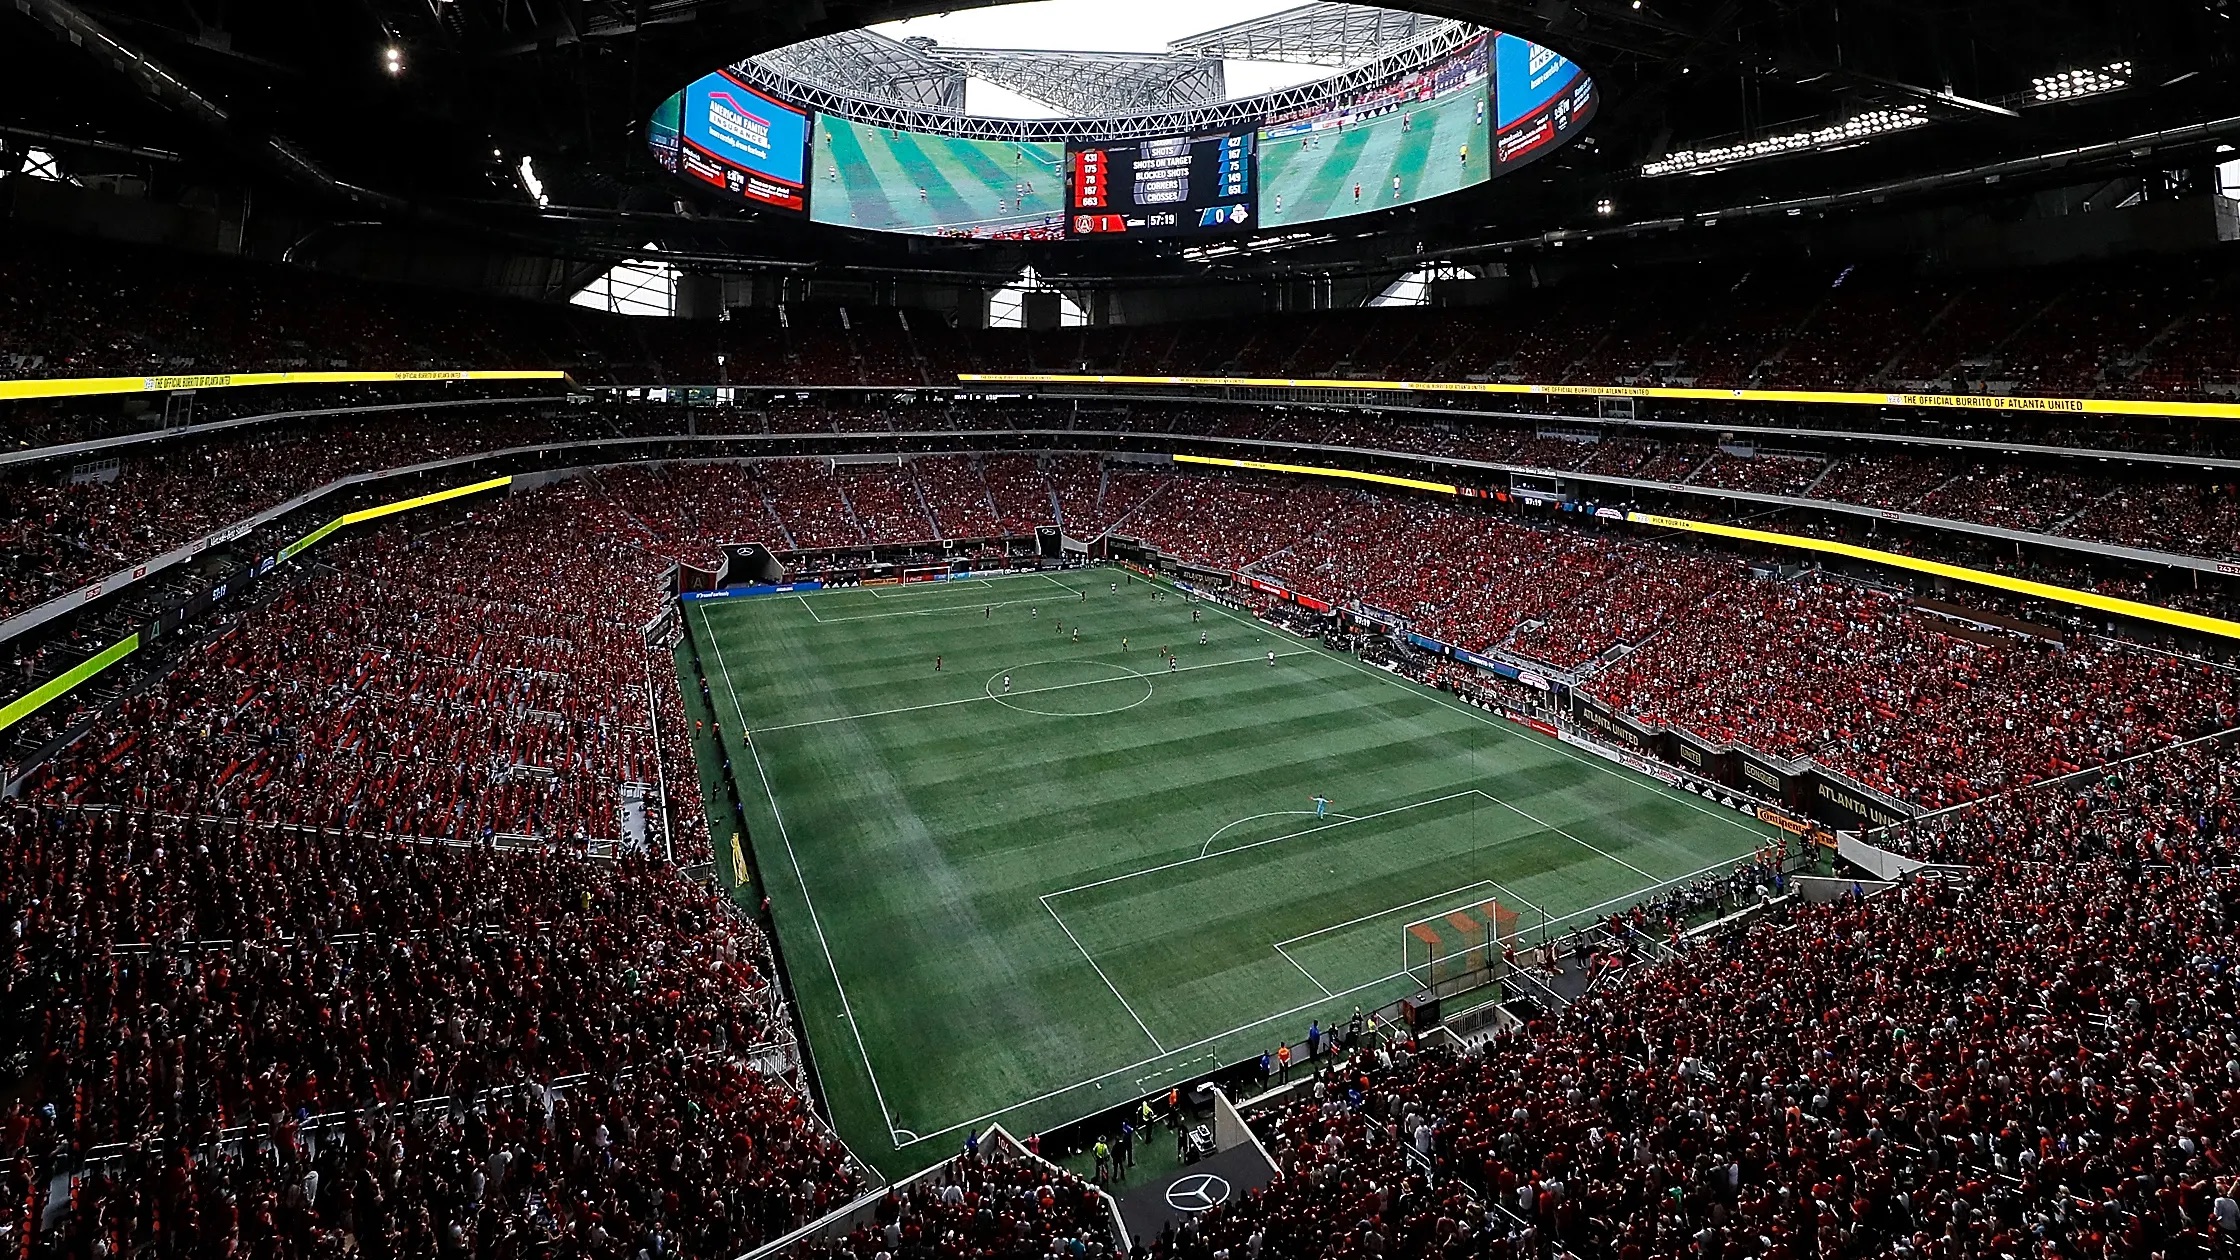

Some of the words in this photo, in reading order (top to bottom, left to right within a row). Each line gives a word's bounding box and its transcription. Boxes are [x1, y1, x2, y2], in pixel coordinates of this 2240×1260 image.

[710, 100, 742, 127] AMERICAN
[743, 118, 769, 137] FAMILY
[713, 115, 763, 144] INSURANCE
[1227, 138, 1242, 148] 427
[1152, 146, 1174, 156] SHOTS
[1228, 150, 1241, 158] 167
[1133, 160, 1155, 170] SHOTS
[1156, 159, 1166, 168] ON
[1166, 156, 1192, 166] TARGET
[1230, 162, 1240, 170] 75
[1084, 165, 1098, 174] 175
[1136, 170, 1166, 180] BLOCKED
[1167, 168, 1190, 178] SHOTS
[1086, 176, 1096, 184] 78
[1228, 173, 1241, 182] 149
[1146, 180, 1178, 190] CORNERS
[1228, 184, 1242, 194] 651
[1084, 186, 1097, 196] 167
[1147, 192, 1178, 202] CROSSES
[1150, 214, 1174, 226] 57:19
[1216, 209, 1224, 223] 0
[1102, 218, 1108, 230] 1
[1904, 396, 1916, 404] THE
[1920, 396, 1953, 406] OFFICIAL
[1956, 398, 1992, 407] BURRITO
[1994, 398, 2004, 408] OF
[2008, 399, 2045, 409] ATLANTA
[2048, 400, 2082, 410] UNITED
[1525, 498, 1542, 506] 57:19
[2218, 566, 2240, 574] 243-2
[1584, 708, 1611, 731] ATLANTA
[1612, 724, 1638, 746] UNITED
[1573, 738, 1592, 752] Georgia
[1682, 746, 1699, 763] UNITE
[1626, 756, 1644, 768] ARROW
[1658, 770, 1676, 780] ARROW
[1746, 764, 1778, 786] CONQUER
[1818, 784, 1867, 817] ATLANTA
